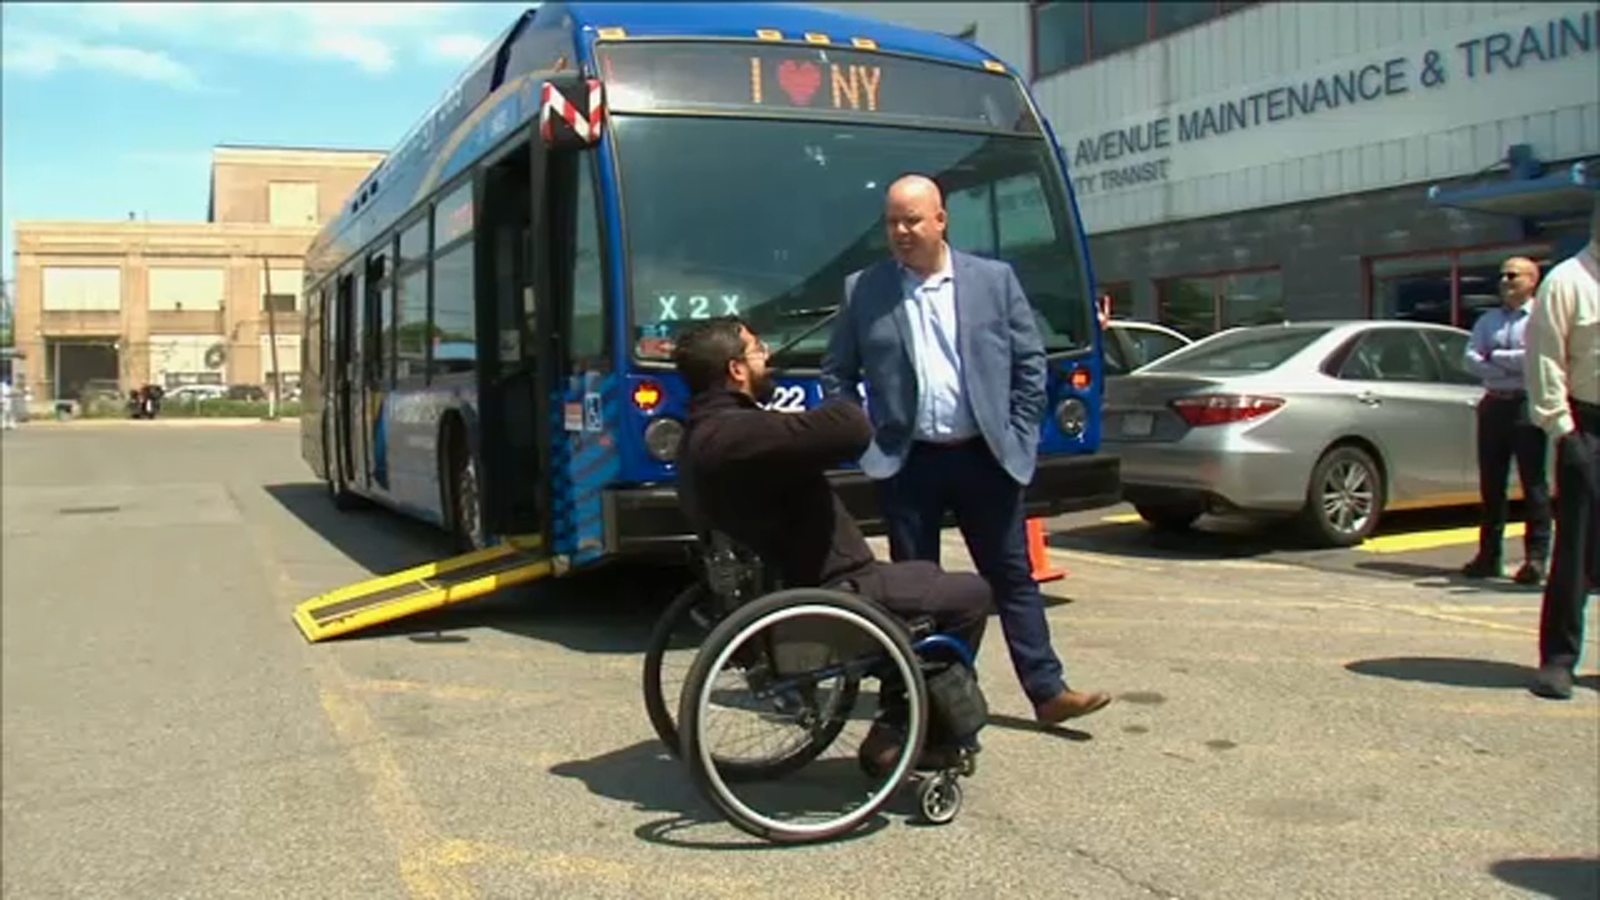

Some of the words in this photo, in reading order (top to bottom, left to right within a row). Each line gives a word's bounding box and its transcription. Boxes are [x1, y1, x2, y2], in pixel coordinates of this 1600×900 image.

[751, 57, 762, 104] I
[830, 62, 881, 112] NY
[1075, 117, 1171, 168] AVENUE
[1178, 58, 1409, 142] MAINTENANCE
[1420, 50, 1445, 88] &
[1074, 174, 1097, 194] TY
[659, 296, 678, 320] X
[689, 296, 711, 319] 2
[722, 295, 739, 316] X
[756, 386, 806, 413] 22
